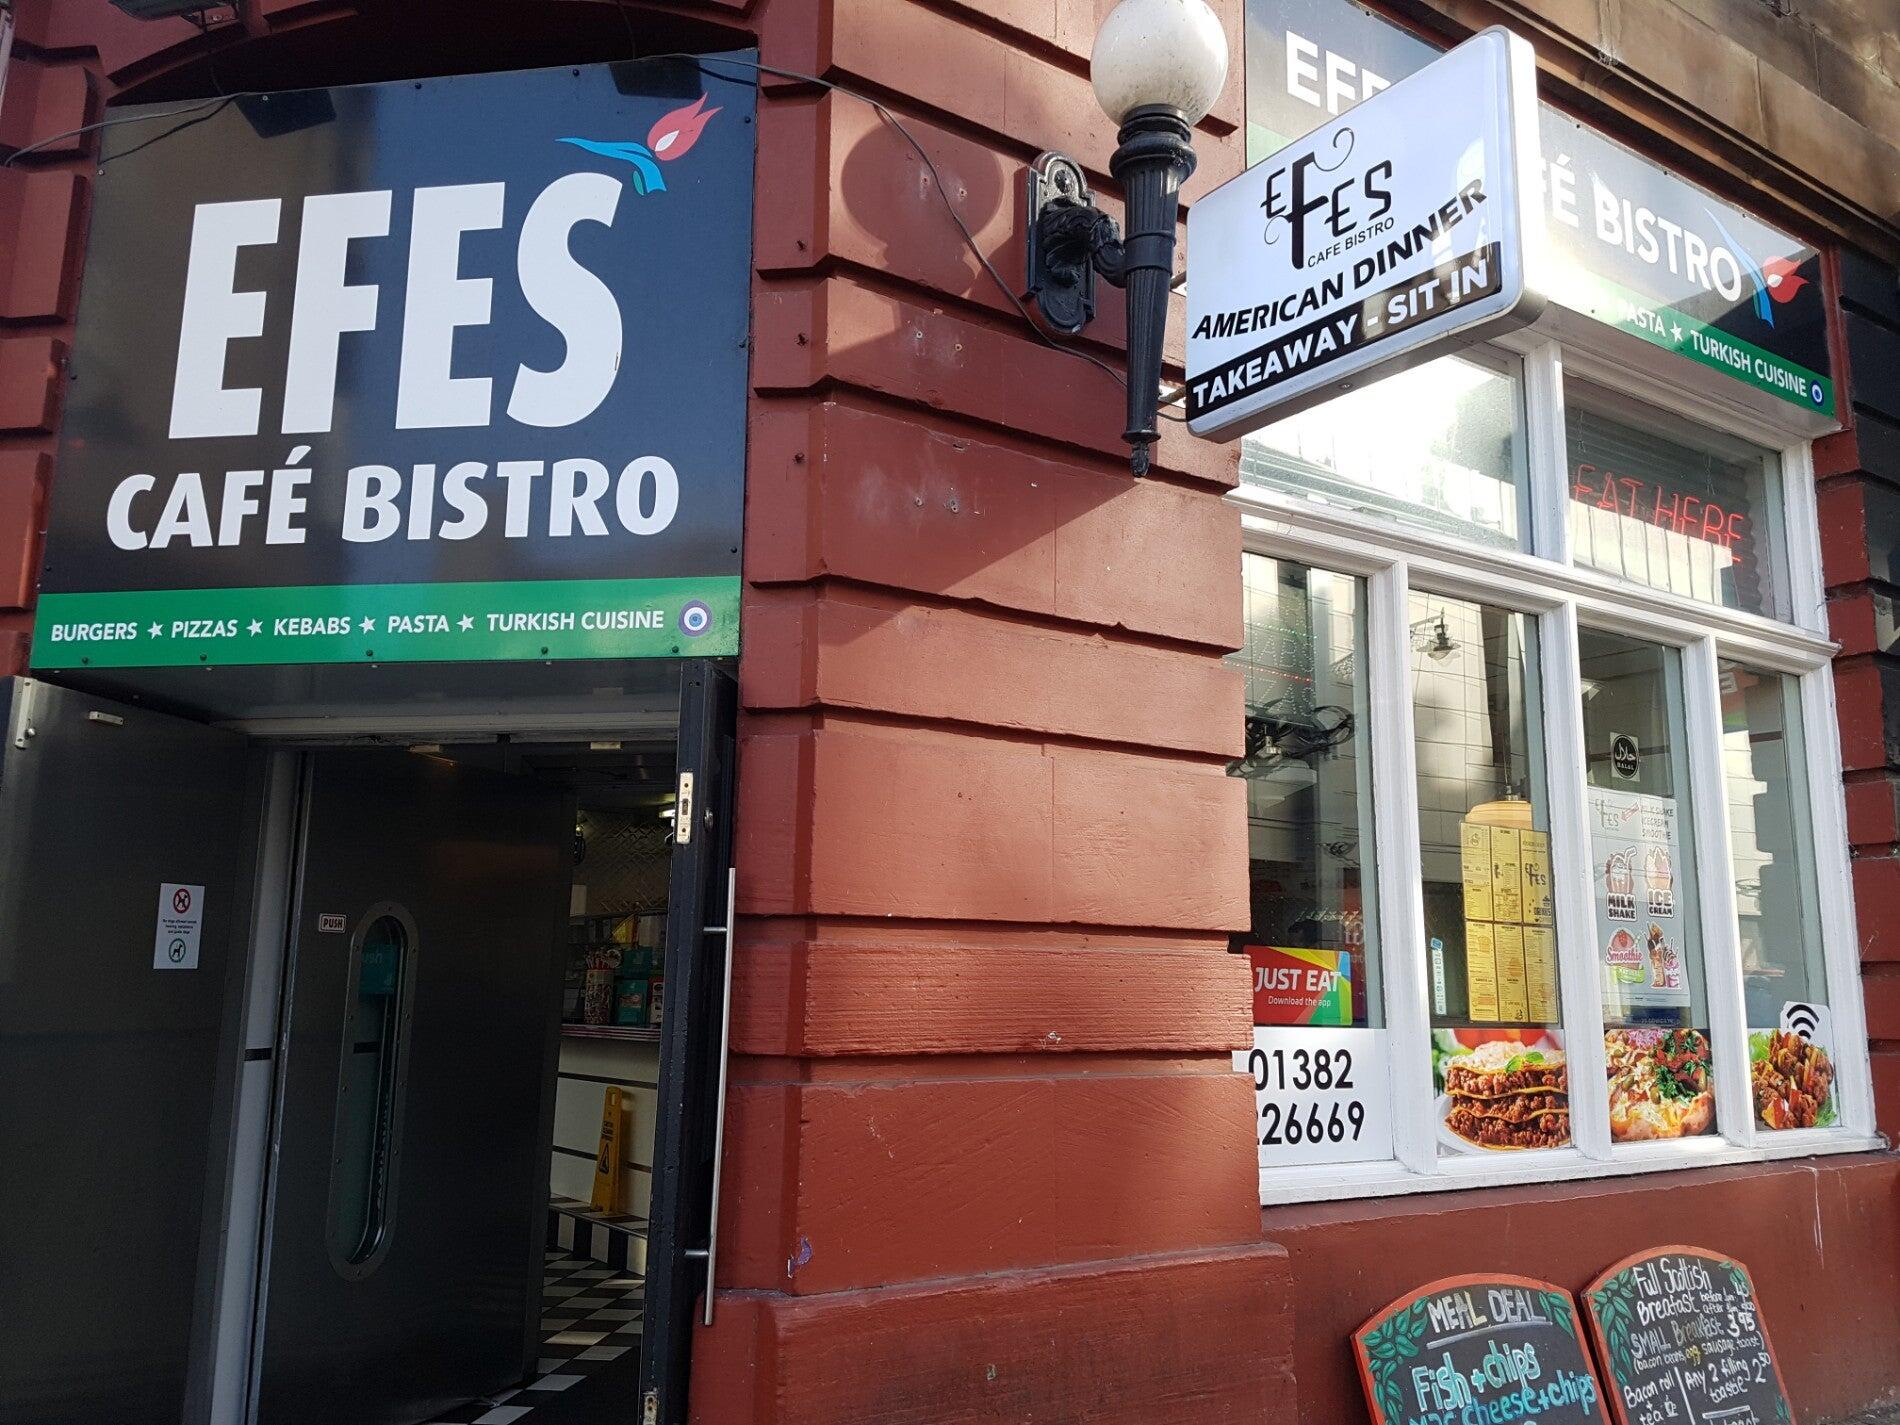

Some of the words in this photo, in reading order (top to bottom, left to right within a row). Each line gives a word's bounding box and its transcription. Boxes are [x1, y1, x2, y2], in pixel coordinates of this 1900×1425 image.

[1261, 127, 1394, 270] EFES
[1192, 272, 1344, 340] AMERICAN
[1354, 178, 1487, 289] DINNER
[1307, 242, 1341, 268] CAFE
[1345, 217, 1394, 250] BISTRO
[1592, 183, 1742, 302] BISTRO
[169, 172, 623, 439] EFES
[1193, 314, 1357, 409] TAKEAWAY
[1387, 278, 1440, 325] SIT
[1451, 259, 1488, 303] IN
[1690, 329, 1751, 373] TURKISH
[1755, 358, 1808, 398] CUISINE
[106, 445, 312, 550] CAFÉ
[341, 455, 680, 543] BISTRO
[51, 622, 138, 642] BURGERS
[171, 619, 239, 639] PIZZAS
[273, 616, 351, 636] KEBABS
[387, 614, 450, 634] PASTA
[487, 612, 575, 632] TURKISH
[581, 610, 664, 630] CUISINE
[1608, 894, 1635, 909] MILK
[1608, 908, 1636, 920] SHAKE
[1648, 890, 1672, 907] ICE
[1648, 906, 1673, 916] CREAM
[322, 916, 344, 929] PUSH
[1606, 946, 1643, 962] Smoothie
[1254, 967, 1300, 993] JUST
[1306, 969, 1341, 993] EAT
[1268, 995, 1304, 1006] Download
[1305, 996, 1317, 1006] the
[1318, 998, 1331, 1008] app
[1249, 1048, 1354, 1091] 01382
[1257, 1100, 1365, 1146] 26669
[1633, 1262, 1662, 1298] Full
[1660, 1257, 1712, 1294] Scottish
[1427, 1291, 1487, 1333] MEAL
[1488, 1289, 1546, 1323] DEAL
[1631, 1327, 1671, 1359] SMALL
[1671, 1313, 1725, 1347] Breakfast
[1412, 1352, 1472, 1412] Fish
[1483, 1340, 1541, 1390] chips
[1624, 1380, 1659, 1409] Bacon
[1659, 1370, 1675, 1391] roll
[1684, 1370, 1707, 1394] Any
[1708, 1363, 1719, 1382] 2
[1720, 1356, 1751, 1381] filling
[1709, 1376, 1748, 1403] toastie
[1639, 1409, 1664, 1425] tea
